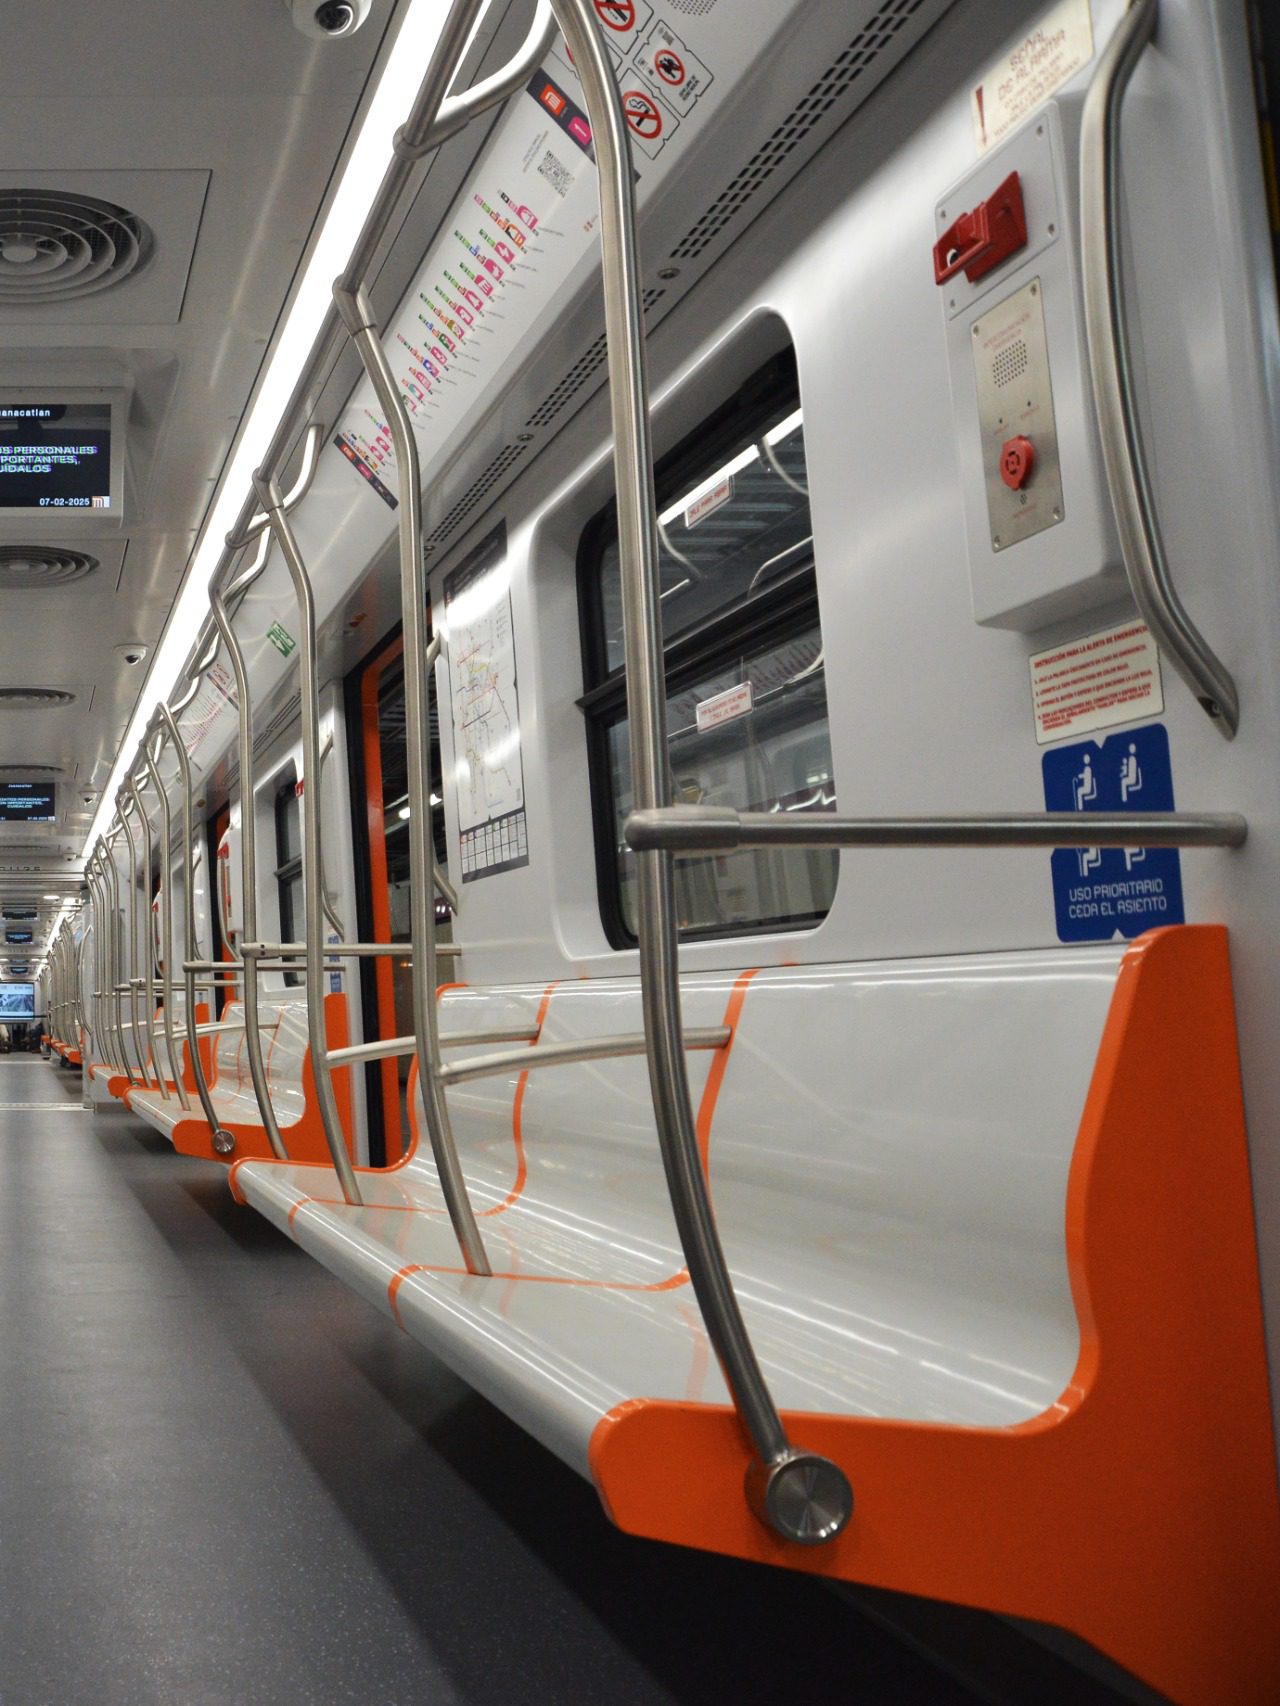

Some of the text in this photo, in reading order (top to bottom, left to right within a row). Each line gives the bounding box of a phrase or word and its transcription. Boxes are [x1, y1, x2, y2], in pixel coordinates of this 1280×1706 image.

[13, 446, 97, 455] PERSONALES
[39, 498, 90, 506] 07-02-2025
[1066, 647, 1079, 657] PARA
[1078, 645, 1086, 654] LA
[1086, 638, 1105, 650] ALERTA
[1106, 636, 1112, 645] DE
[1069, 878, 1163, 902] USO PRIORITARIO
[1068, 896, 1167, 919] CEDA EL ASIENTO
